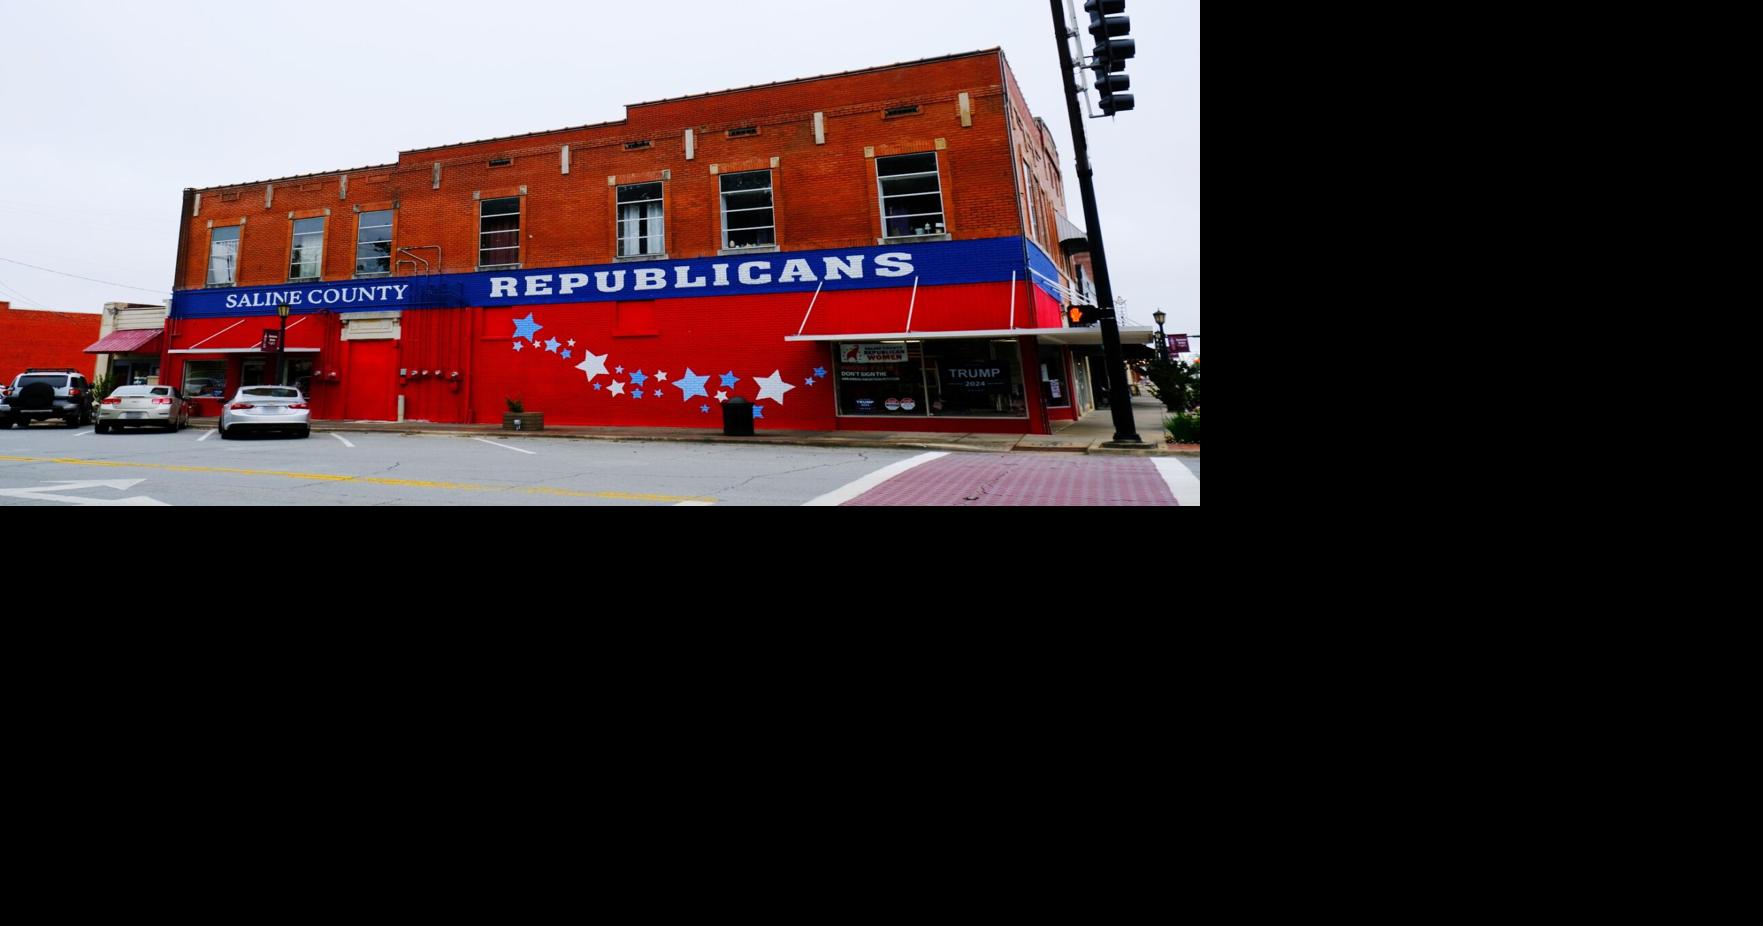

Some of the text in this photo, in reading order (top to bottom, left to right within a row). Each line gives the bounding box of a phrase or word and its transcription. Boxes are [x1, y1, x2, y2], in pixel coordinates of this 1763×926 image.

[490, 252, 914, 297] REPUBLICANS
[226, 285, 408, 308] SALINE COUNTY
[947, 368, 1001, 378] TRUMP
